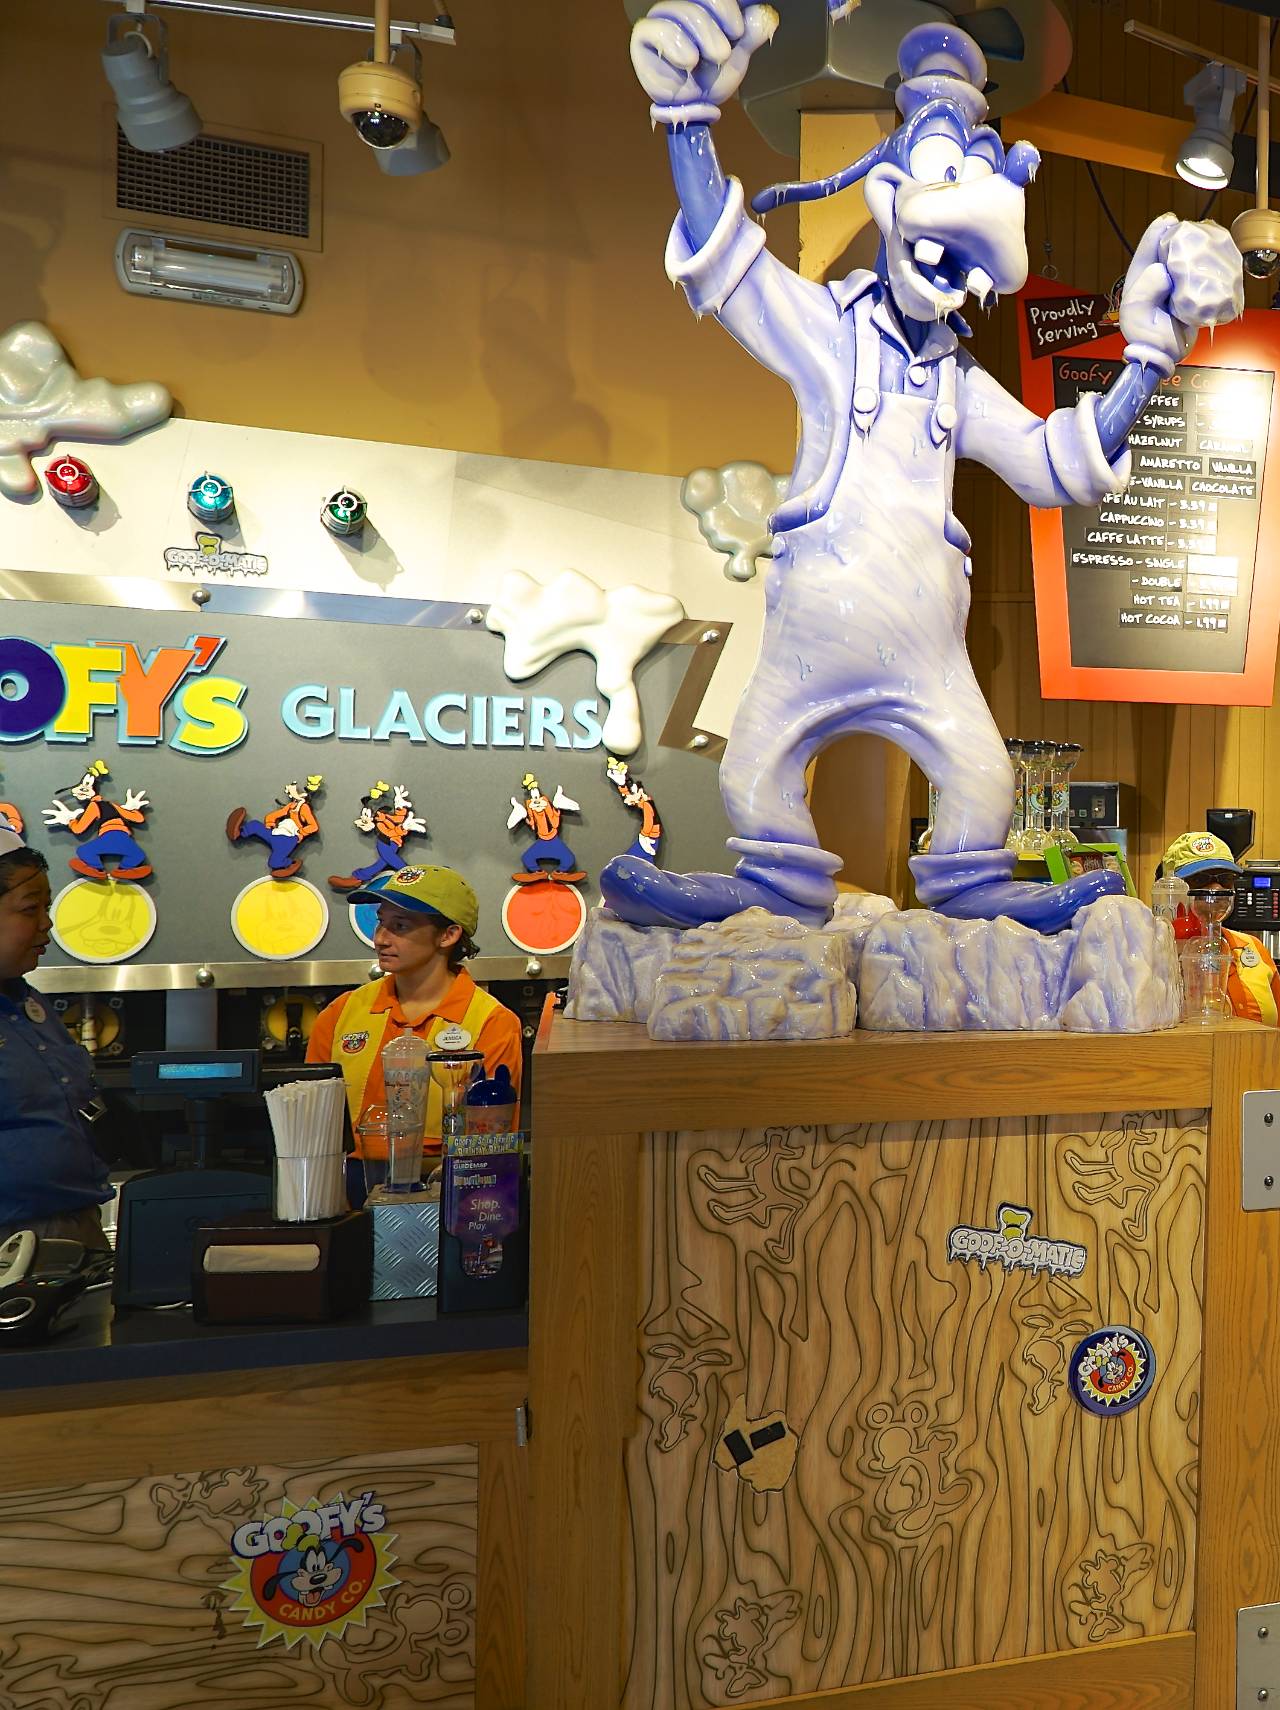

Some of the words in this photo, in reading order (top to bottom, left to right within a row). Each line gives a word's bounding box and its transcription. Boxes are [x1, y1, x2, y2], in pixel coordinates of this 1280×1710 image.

[1029, 298, 1095, 325] Proudly
[1037, 318, 1098, 346] Serving
[1059, 362, 1112, 385] Goofy
[1143, 415, 1185, 428] SYRUPS
[1128, 434, 1183, 448] HAZELNUT
[1139, 455, 1201, 472] AMARETTO
[1211, 462, 1254, 476] VANILLA
[1191, 481, 1255, 497] CHOCOLATE
[1123, 494, 1138, 506] AU
[1139, 496, 1166, 509] LAIT
[1099, 512, 1165, 529] CAPPUCCINO
[1087, 531, 1123, 544] CAFFE
[1126, 534, 1165, 547] LATTE
[1072, 552, 1134, 568] ESPRESSO
[1144, 557, 1185, 570] SINGLE
[1141, 575, 1182, 588] DOUBLE
[1133, 593, 1155, 605] HOT
[1158, 595, 1181, 608] TEA
[1120, 611, 1142, 623] HOT
[1145, 613, 1181, 626] COCOA
[281, 683, 605, 752] GLACIERS
[453, 1162, 488, 1170] GUIDEMAP
[470, 1198, 501, 1212] Shop.
[478, 1211, 504, 1222] Dine.
[468, 1221, 487, 1232] Play.
[951, 1228, 1086, 1270] GOOF-O-MATIC
[1077, 1332, 1129, 1378] GOOFY'S
[1107, 1377, 1130, 1396] CANDY
[1125, 1363, 1136, 1380] CO.
[231, 1490, 387, 1559] GOOFY'S
[279, 1603, 337, 1621] CANDY
[341, 1578, 367, 1604] CO.
